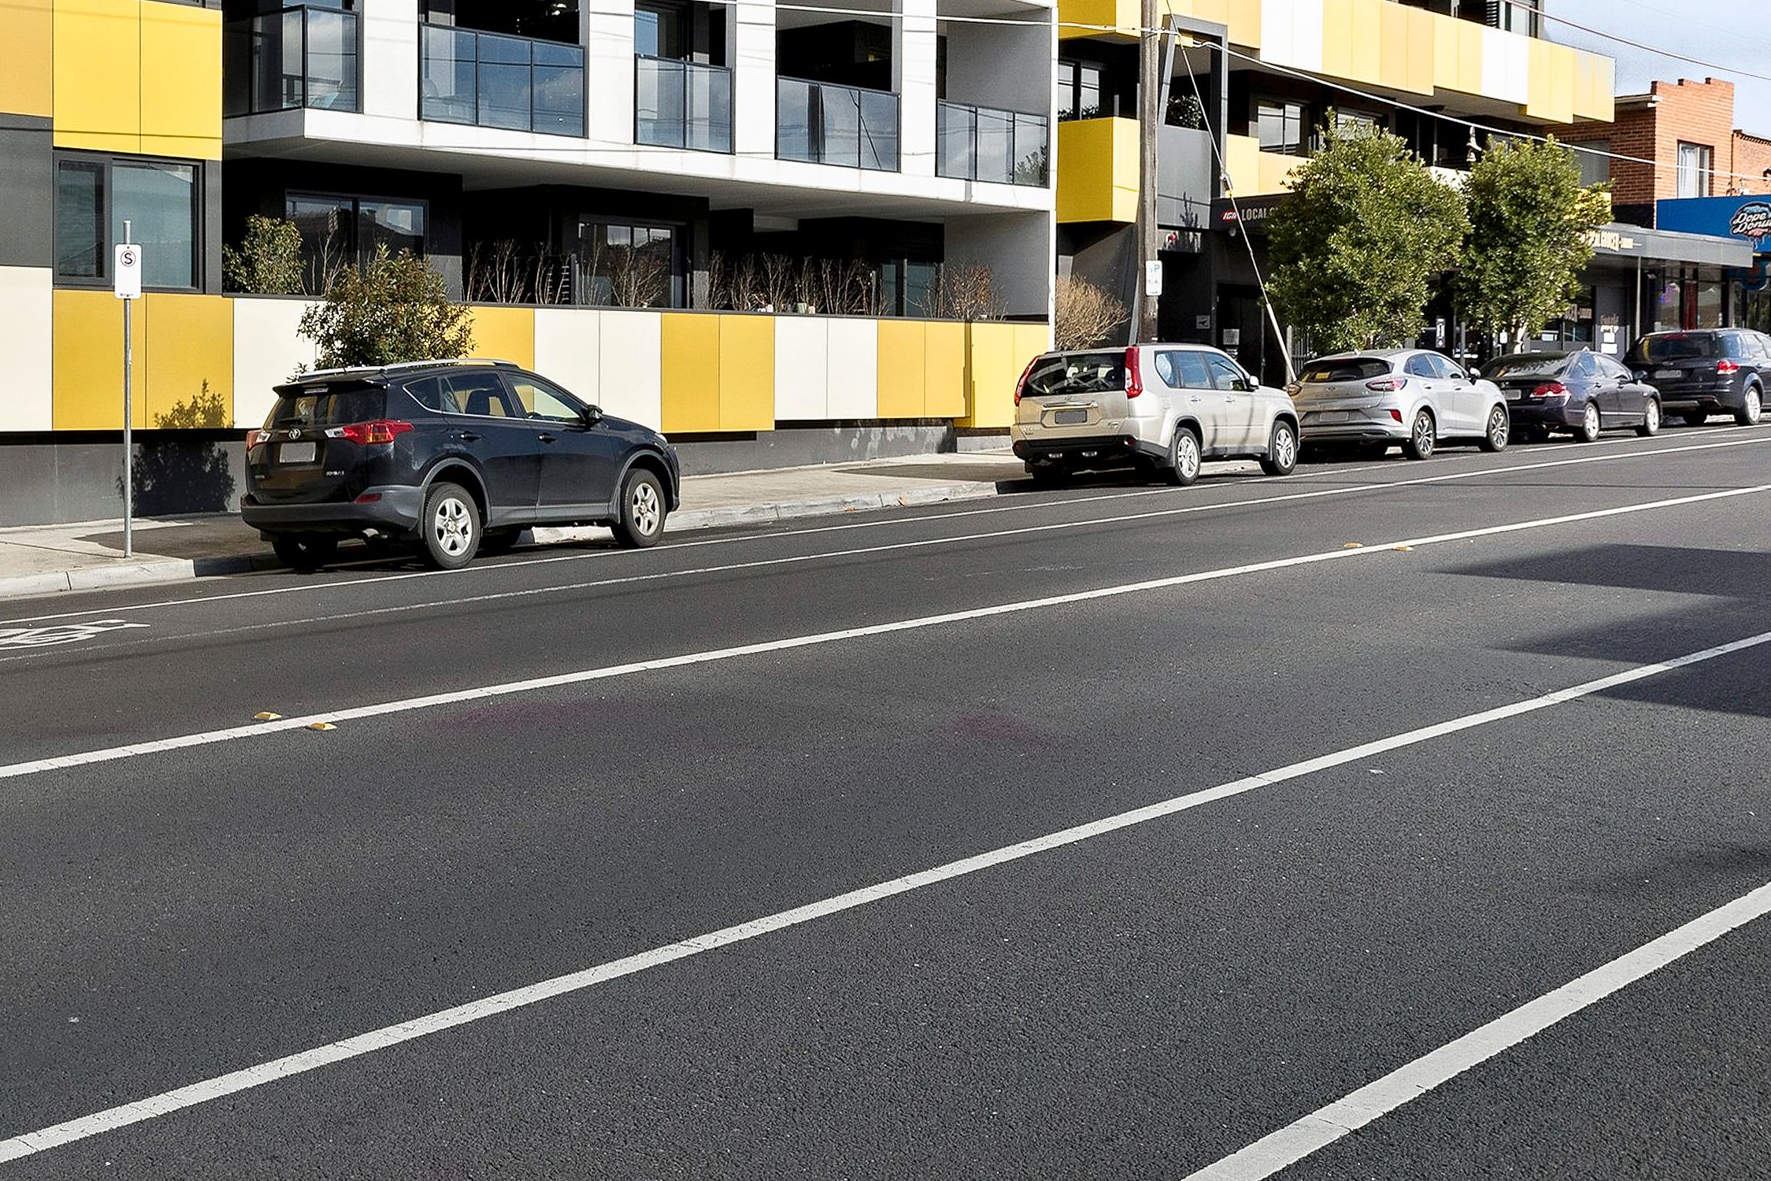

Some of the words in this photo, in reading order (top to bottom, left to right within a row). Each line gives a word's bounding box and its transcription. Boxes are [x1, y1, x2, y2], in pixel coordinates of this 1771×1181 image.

[1241, 208, 1267, 221] LOCAL
[1732, 212, 1767, 225] Dope
[124, 252, 133, 265] S
